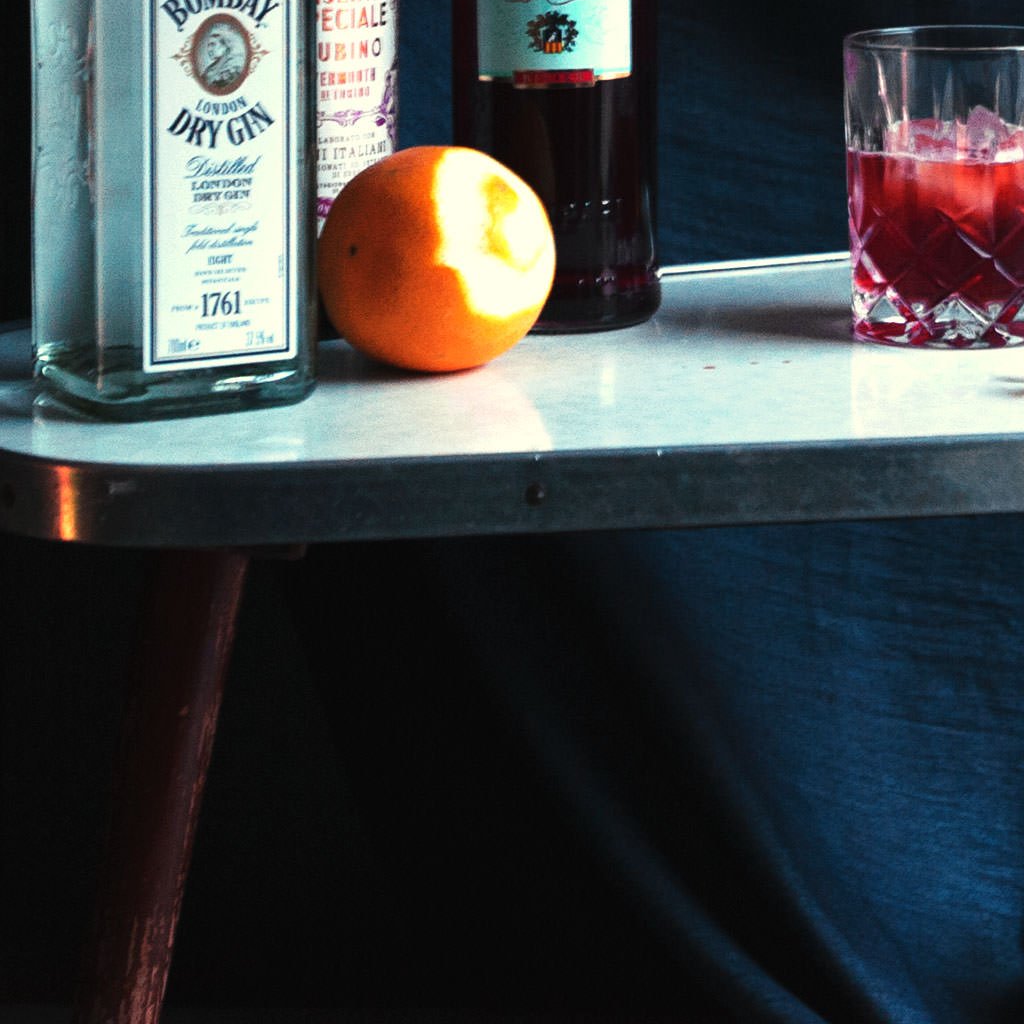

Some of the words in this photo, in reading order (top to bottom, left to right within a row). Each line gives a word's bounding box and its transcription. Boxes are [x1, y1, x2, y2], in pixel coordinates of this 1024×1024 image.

[316, 2, 387, 32] ECIALE
[318, 37, 382, 62] UBINO
[319, 67, 376, 86] ERMOUTH
[195, 95, 248, 116] LONDON
[167, 107, 224, 149] DRY
[226, 101, 275, 146] GIN
[184, 154, 263, 179] Distilled
[191, 177, 253, 191] LONDON
[192, 191, 222, 203] DRY
[224, 189, 251, 201] GIN
[200, 290, 241, 318] 1761
